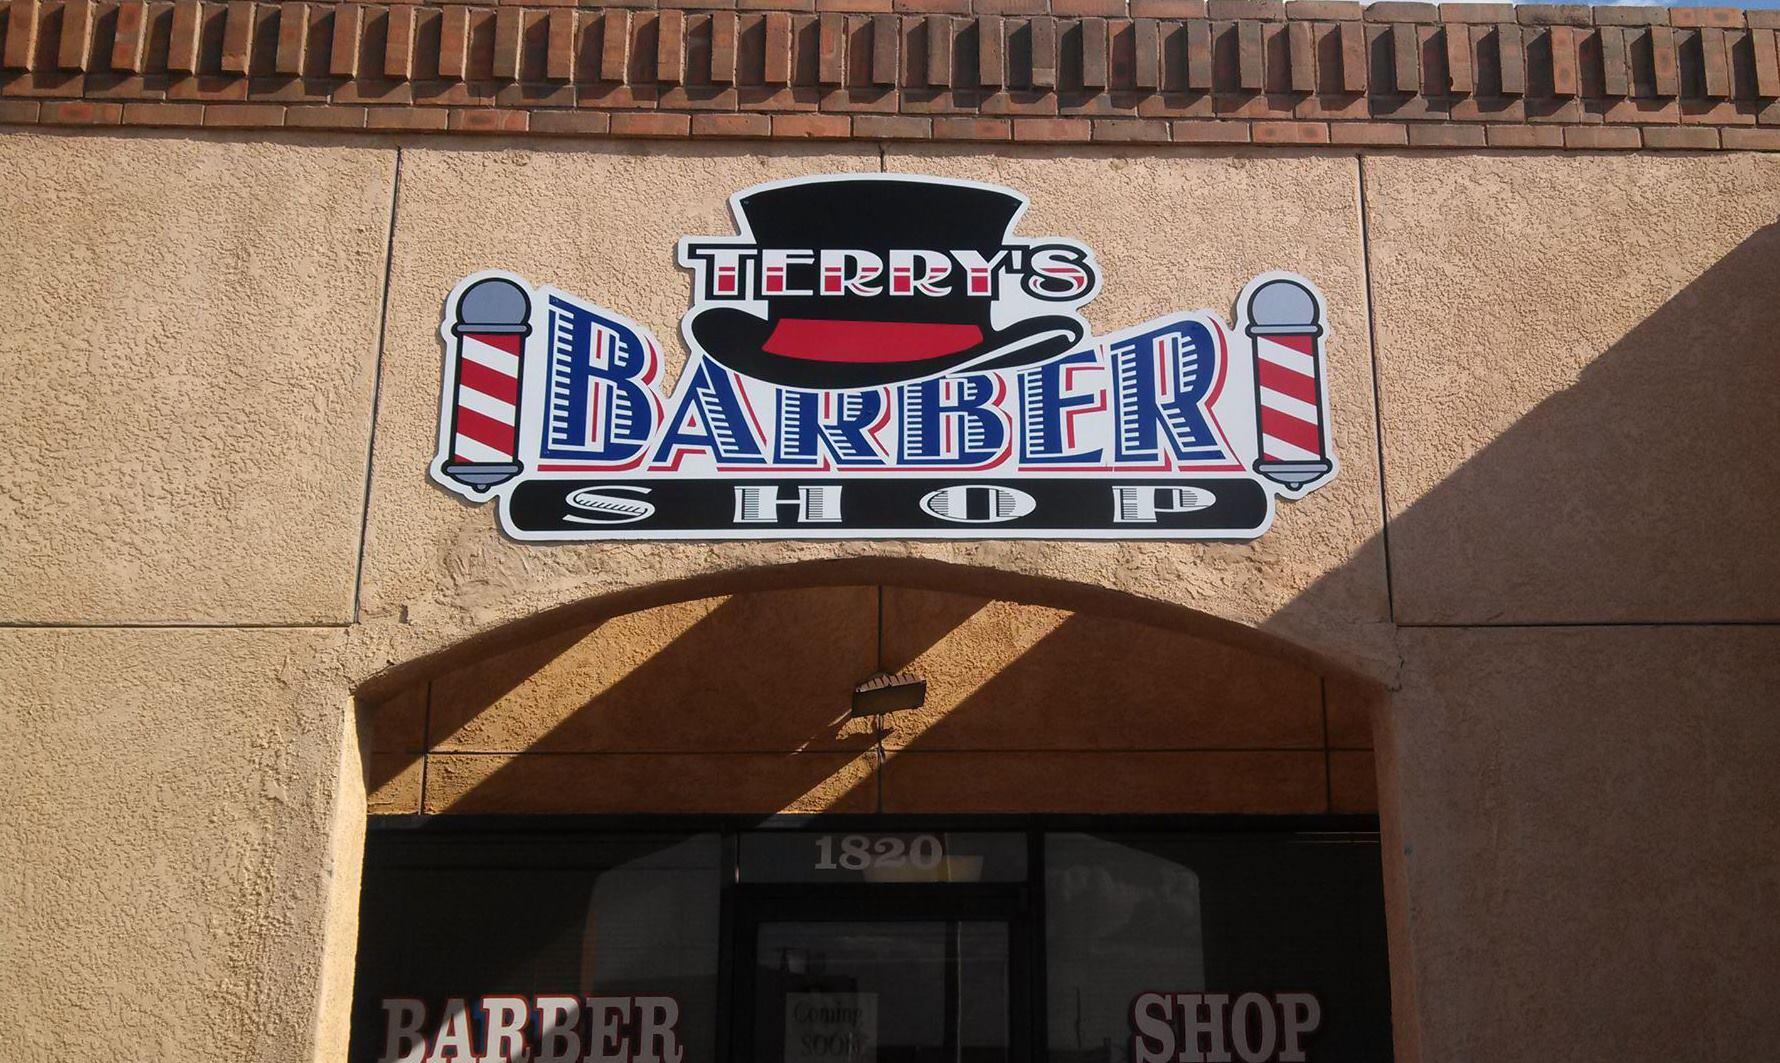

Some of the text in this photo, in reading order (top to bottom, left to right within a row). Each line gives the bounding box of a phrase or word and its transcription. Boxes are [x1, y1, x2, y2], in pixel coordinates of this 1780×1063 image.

[694, 248, 1088, 298] TERRY'S
[538, 294, 1247, 472] BARBER
[562, 484, 1217, 524] SHOP
[814, 834, 943, 871] 1820
[378, 991, 1322, 1063] BARBER SHOP
[792, 999, 864, 1028] Coming
